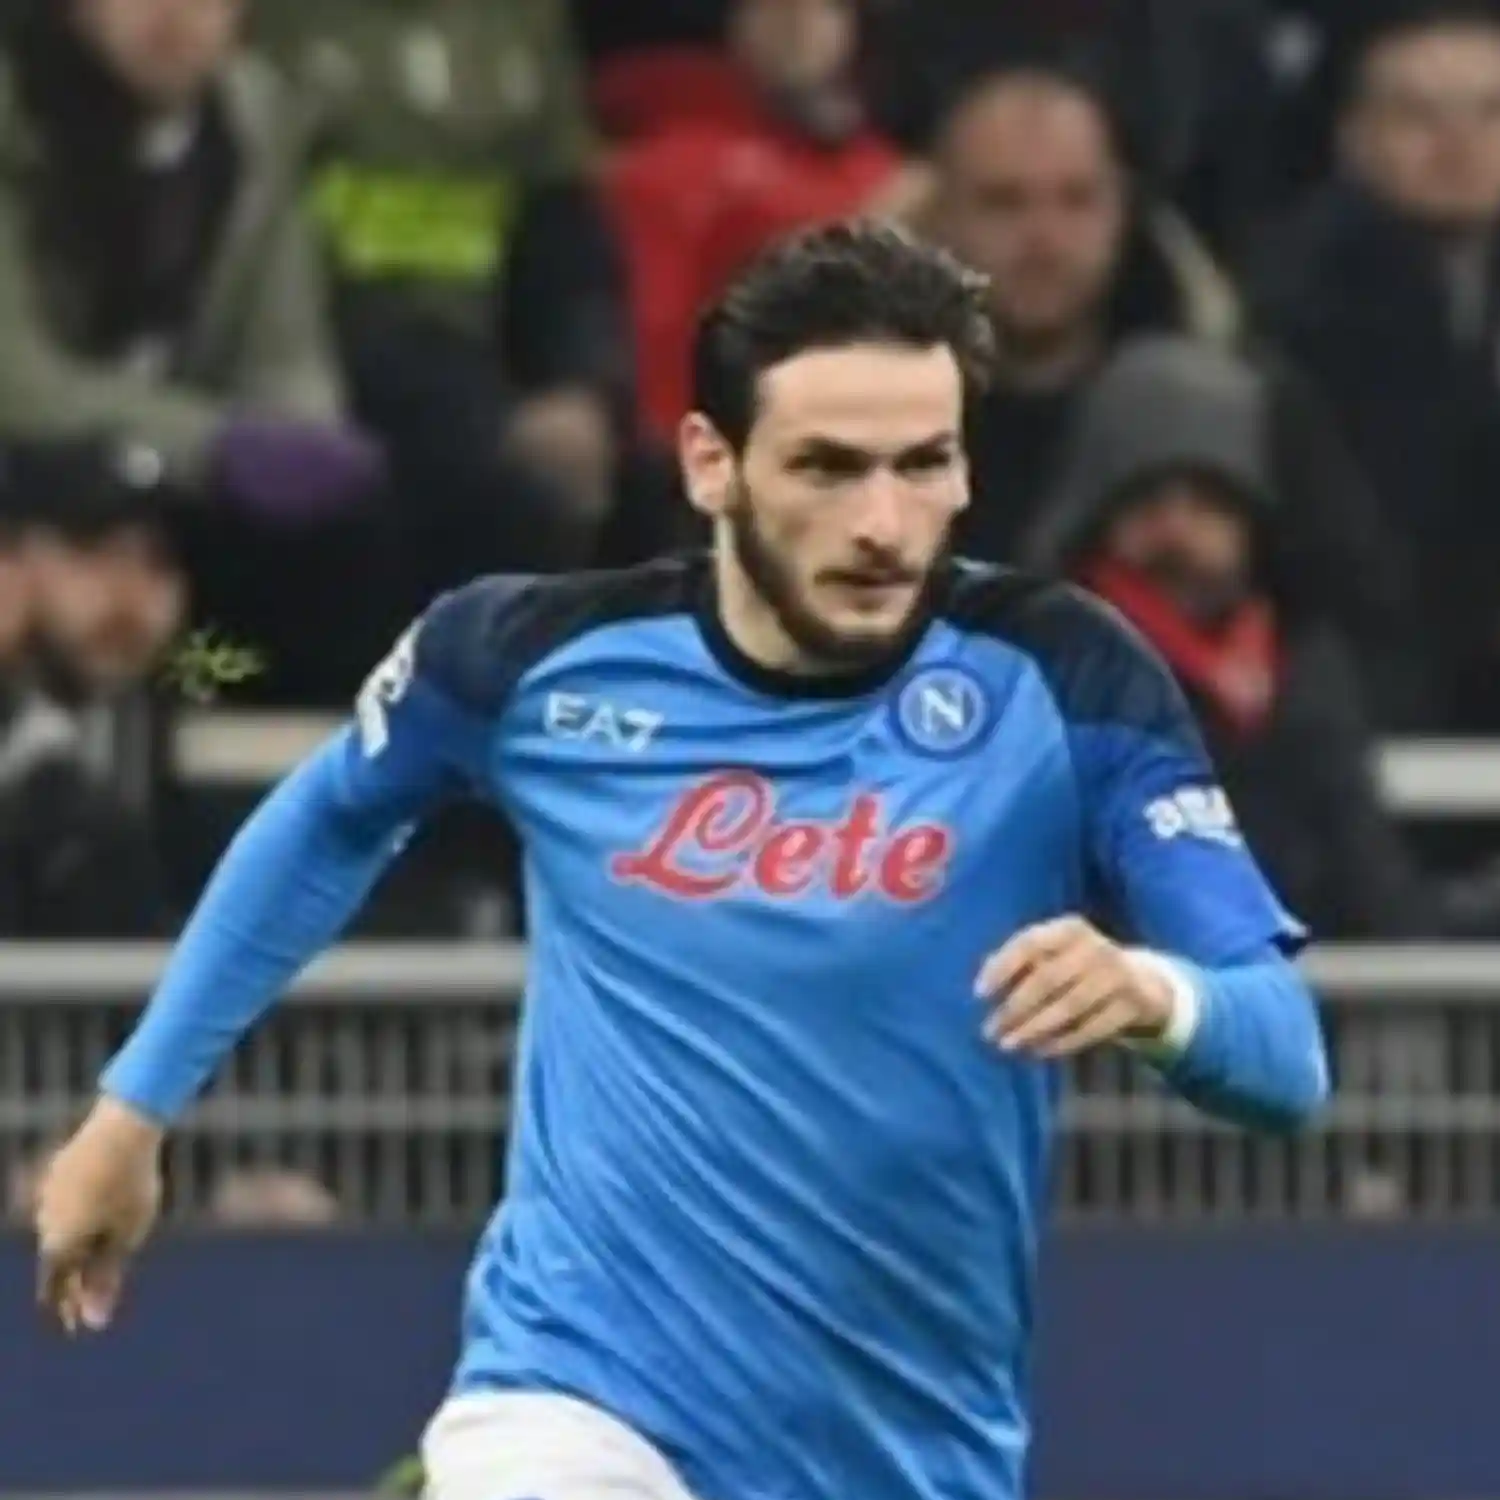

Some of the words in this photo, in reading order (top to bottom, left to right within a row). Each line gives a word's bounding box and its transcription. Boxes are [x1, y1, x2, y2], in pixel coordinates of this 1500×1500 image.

[545, 692, 663, 752] EA7
[921, 685, 966, 733] N
[610, 770, 951, 901] Lete
